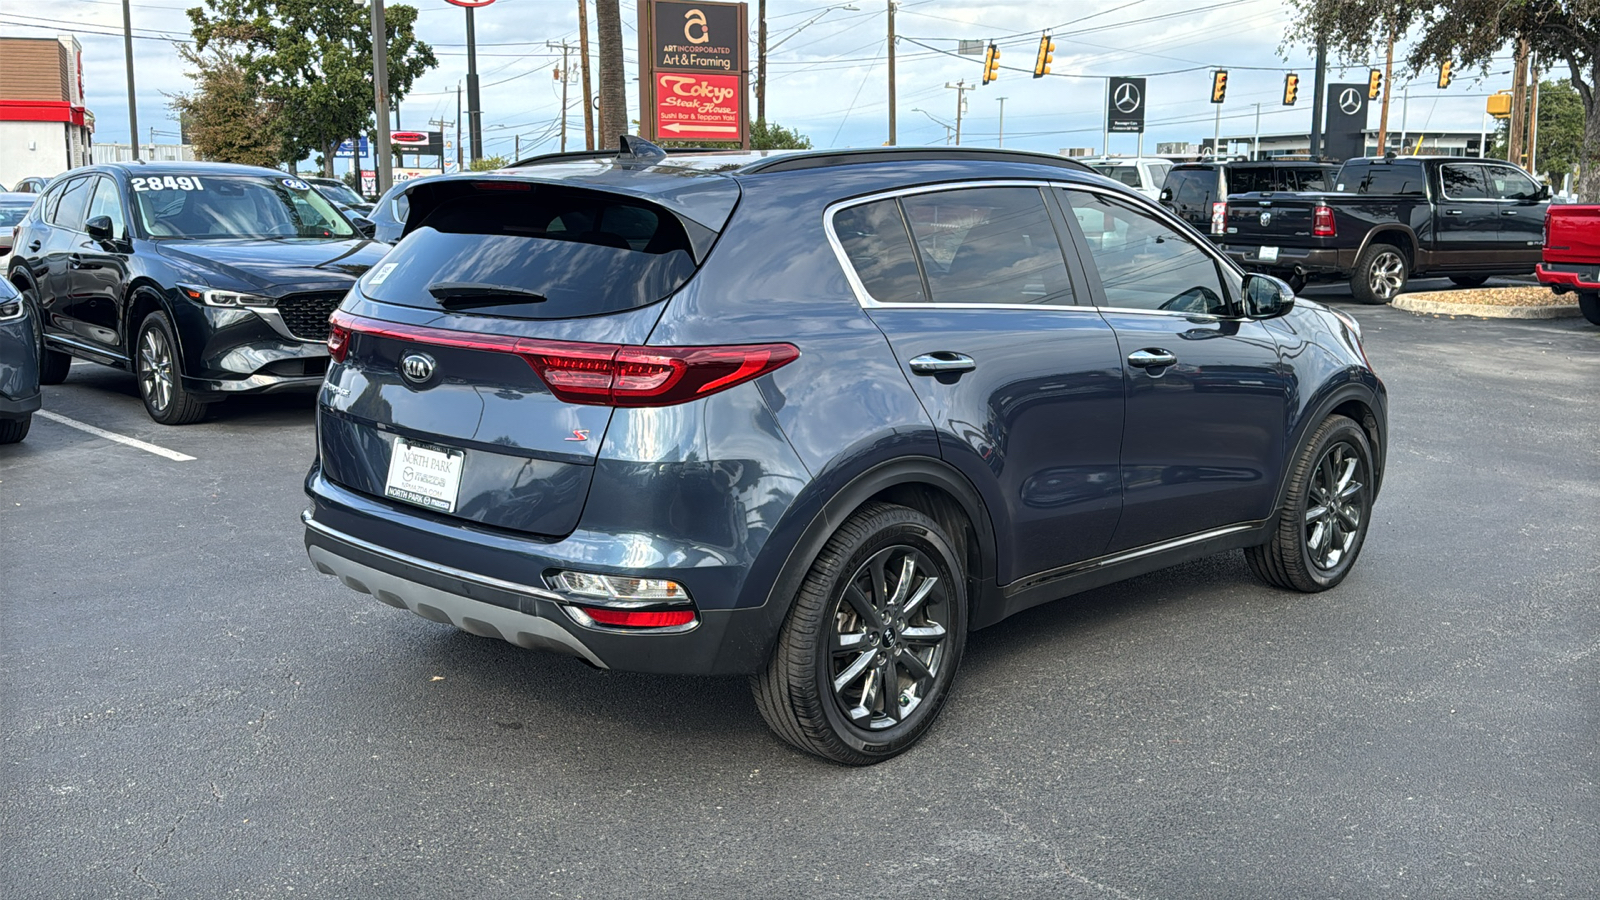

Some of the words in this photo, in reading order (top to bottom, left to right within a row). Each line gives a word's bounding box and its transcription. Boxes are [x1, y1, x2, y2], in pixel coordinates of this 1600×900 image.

[663, 54, 679, 65] Art
[681, 54, 689, 65] &
[690, 54, 730, 70] Framing
[660, 75, 734, 104] Tokyo
[660, 96, 700, 108] Steak
[698, 103, 737, 114] House
[697, 113, 721, 121] Teppan
[131, 176, 204, 192] 28491
[405, 360, 426, 377] KIA
[402, 451, 429, 468] NORTH
[431, 458, 453, 473] PARK
[389, 488, 407, 498] NORTH
[408, 493, 423, 504] PARK
